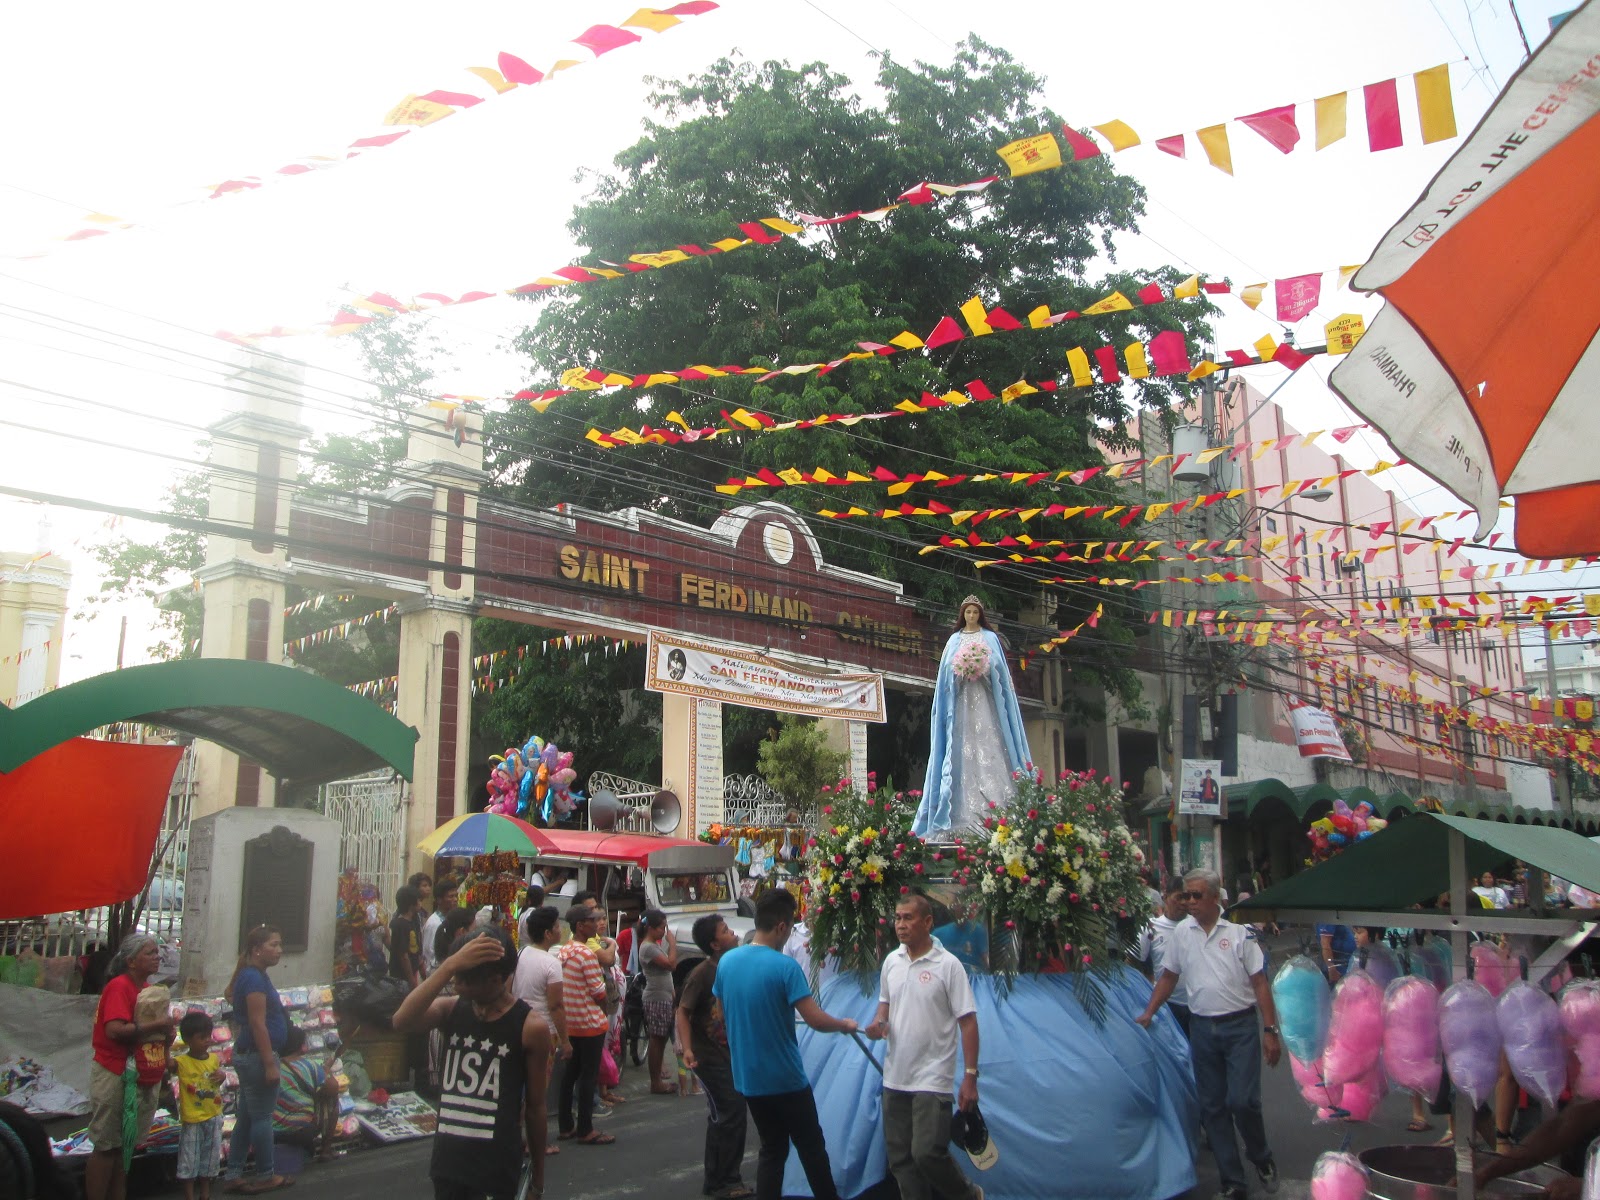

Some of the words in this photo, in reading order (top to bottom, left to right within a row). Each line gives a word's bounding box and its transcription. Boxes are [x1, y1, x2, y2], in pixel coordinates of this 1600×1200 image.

[1328, 324, 1349, 334] Miguel
[560, 544, 650, 593] SAINT
[678, 573, 813, 630] FERDINAND
[836, 611, 941, 662] CATHEDRL
[693, 671, 721, 685] Mayor
[710, 665, 737, 678] SAN
[822, 686, 844, 697] HARI
[721, 658, 780, 678] Maligayang
[785, 672, 838, 687] Kapistahan
[442, 1049, 500, 1099] USA
